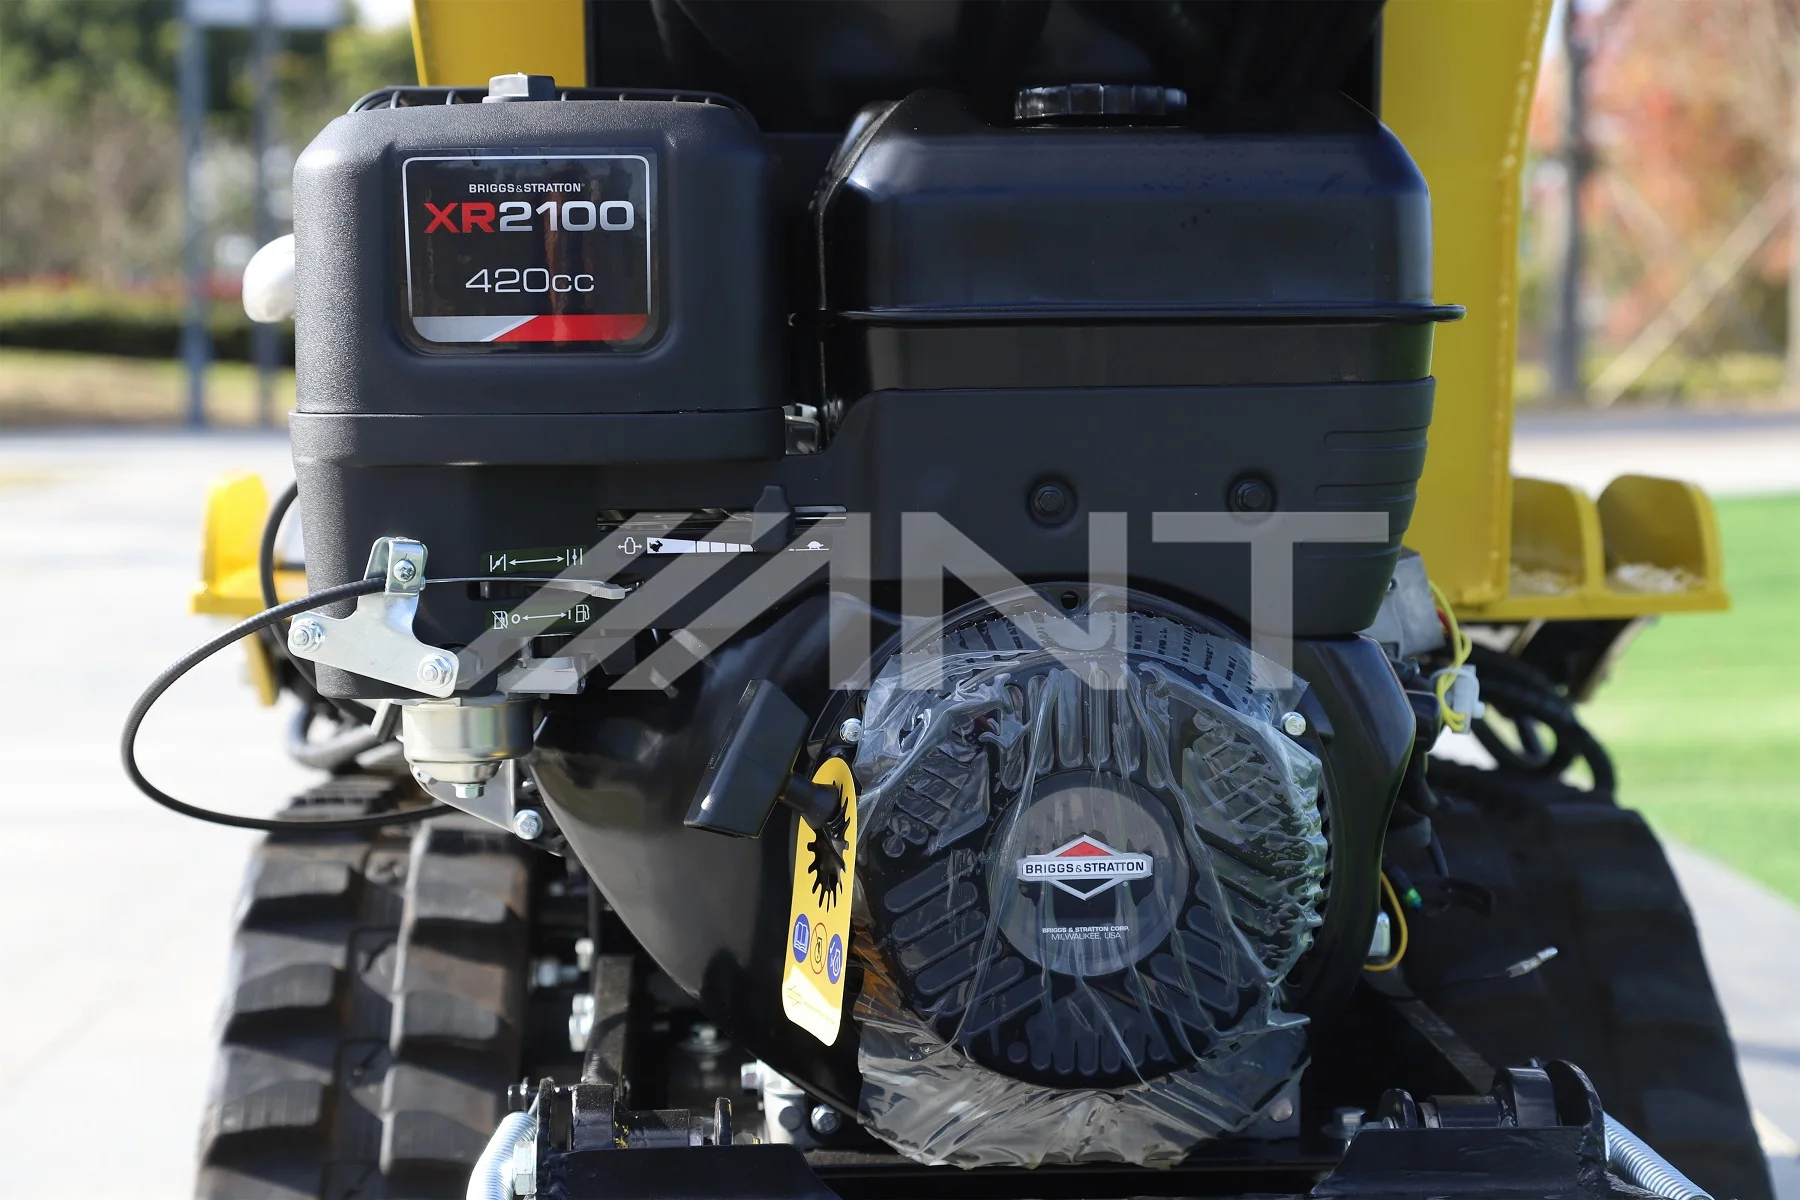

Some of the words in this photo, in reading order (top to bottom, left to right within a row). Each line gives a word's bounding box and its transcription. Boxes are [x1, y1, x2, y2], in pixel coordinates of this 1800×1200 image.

[424, 201, 634, 233] XR2100
[465, 268, 595, 293] 420cc
[1051, 932, 1102, 941] MILWAUKEE,
[1104, 931, 1122, 939] USA
